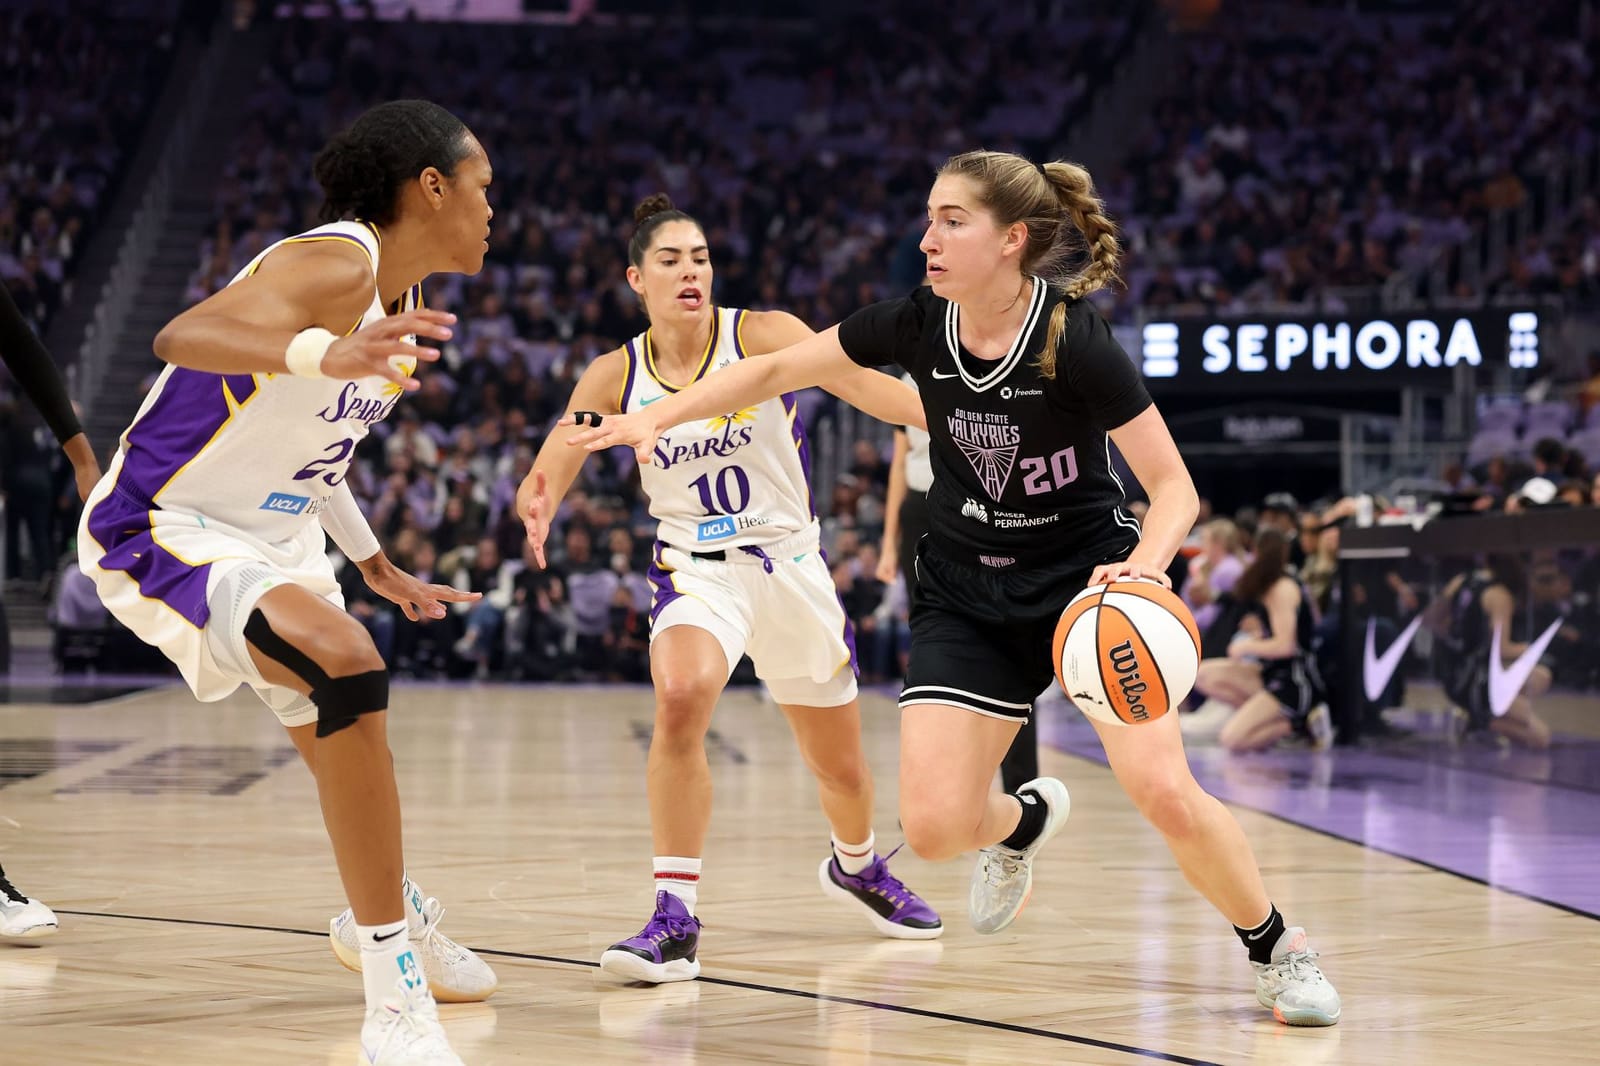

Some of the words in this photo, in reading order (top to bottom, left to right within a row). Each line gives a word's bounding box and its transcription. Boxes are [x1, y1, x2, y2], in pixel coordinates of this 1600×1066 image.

[1202, 318, 1482, 374] SEPHORA
[1014, 388, 1043, 398] freedom
[955, 408, 983, 423] GOLDEN
[985, 413, 1009, 424] STATE
[947, 416, 1021, 448] VALKYRIES
[1019, 446, 1079, 496] 20
[688, 465, 750, 516] 10
[268, 498, 301, 511] UCLA
[993, 510, 1026, 519] KAISER
[702, 523, 732, 537] UCLA
[738, 516, 771, 530] Hea
[994, 513, 1060, 528] PERMANENTE
[1109, 638, 1150, 722] Wilson
